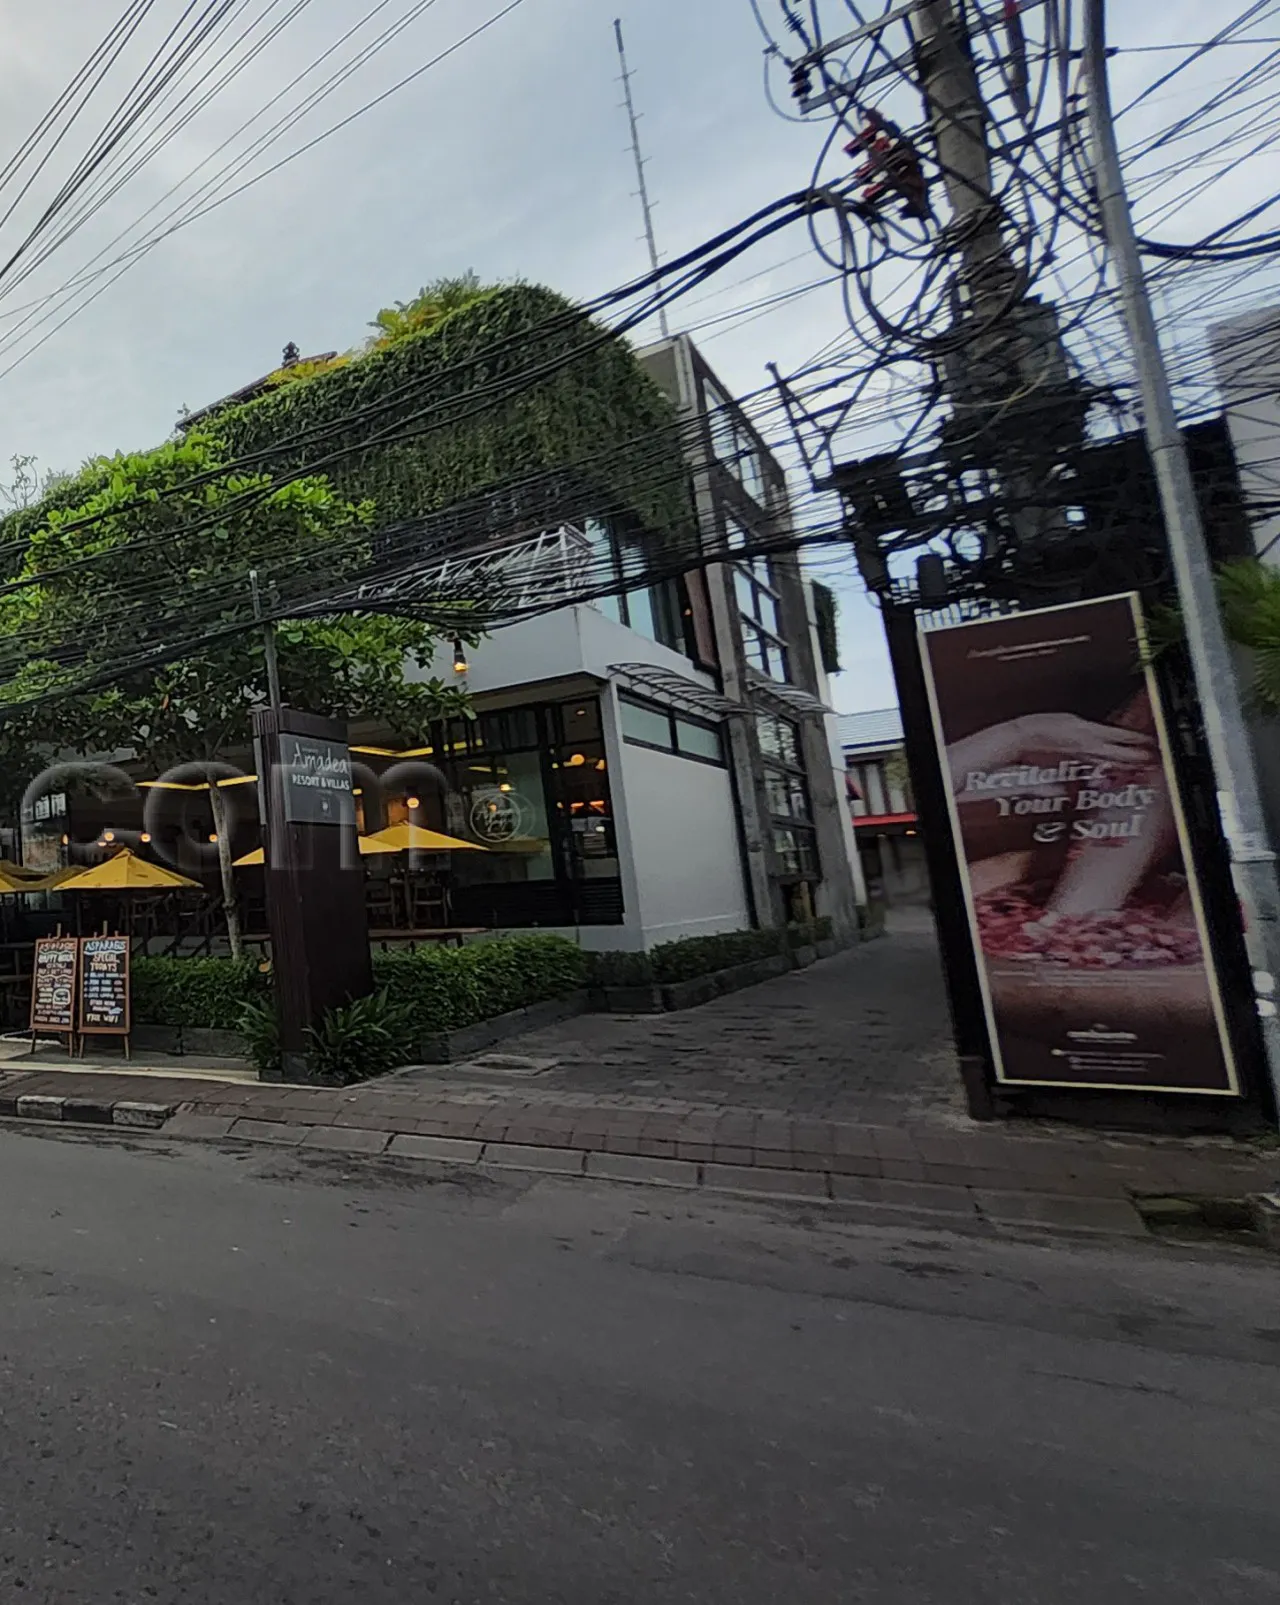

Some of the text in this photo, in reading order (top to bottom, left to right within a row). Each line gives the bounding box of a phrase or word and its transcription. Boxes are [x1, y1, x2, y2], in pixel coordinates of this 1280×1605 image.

[291, 742, 349, 774] Amadea
[291, 773, 320, 787] RESORT
[326, 777, 350, 791] VILLAS
[996, 783, 1156, 818] Your Body
[1033, 813, 1145, 843] & Soul
